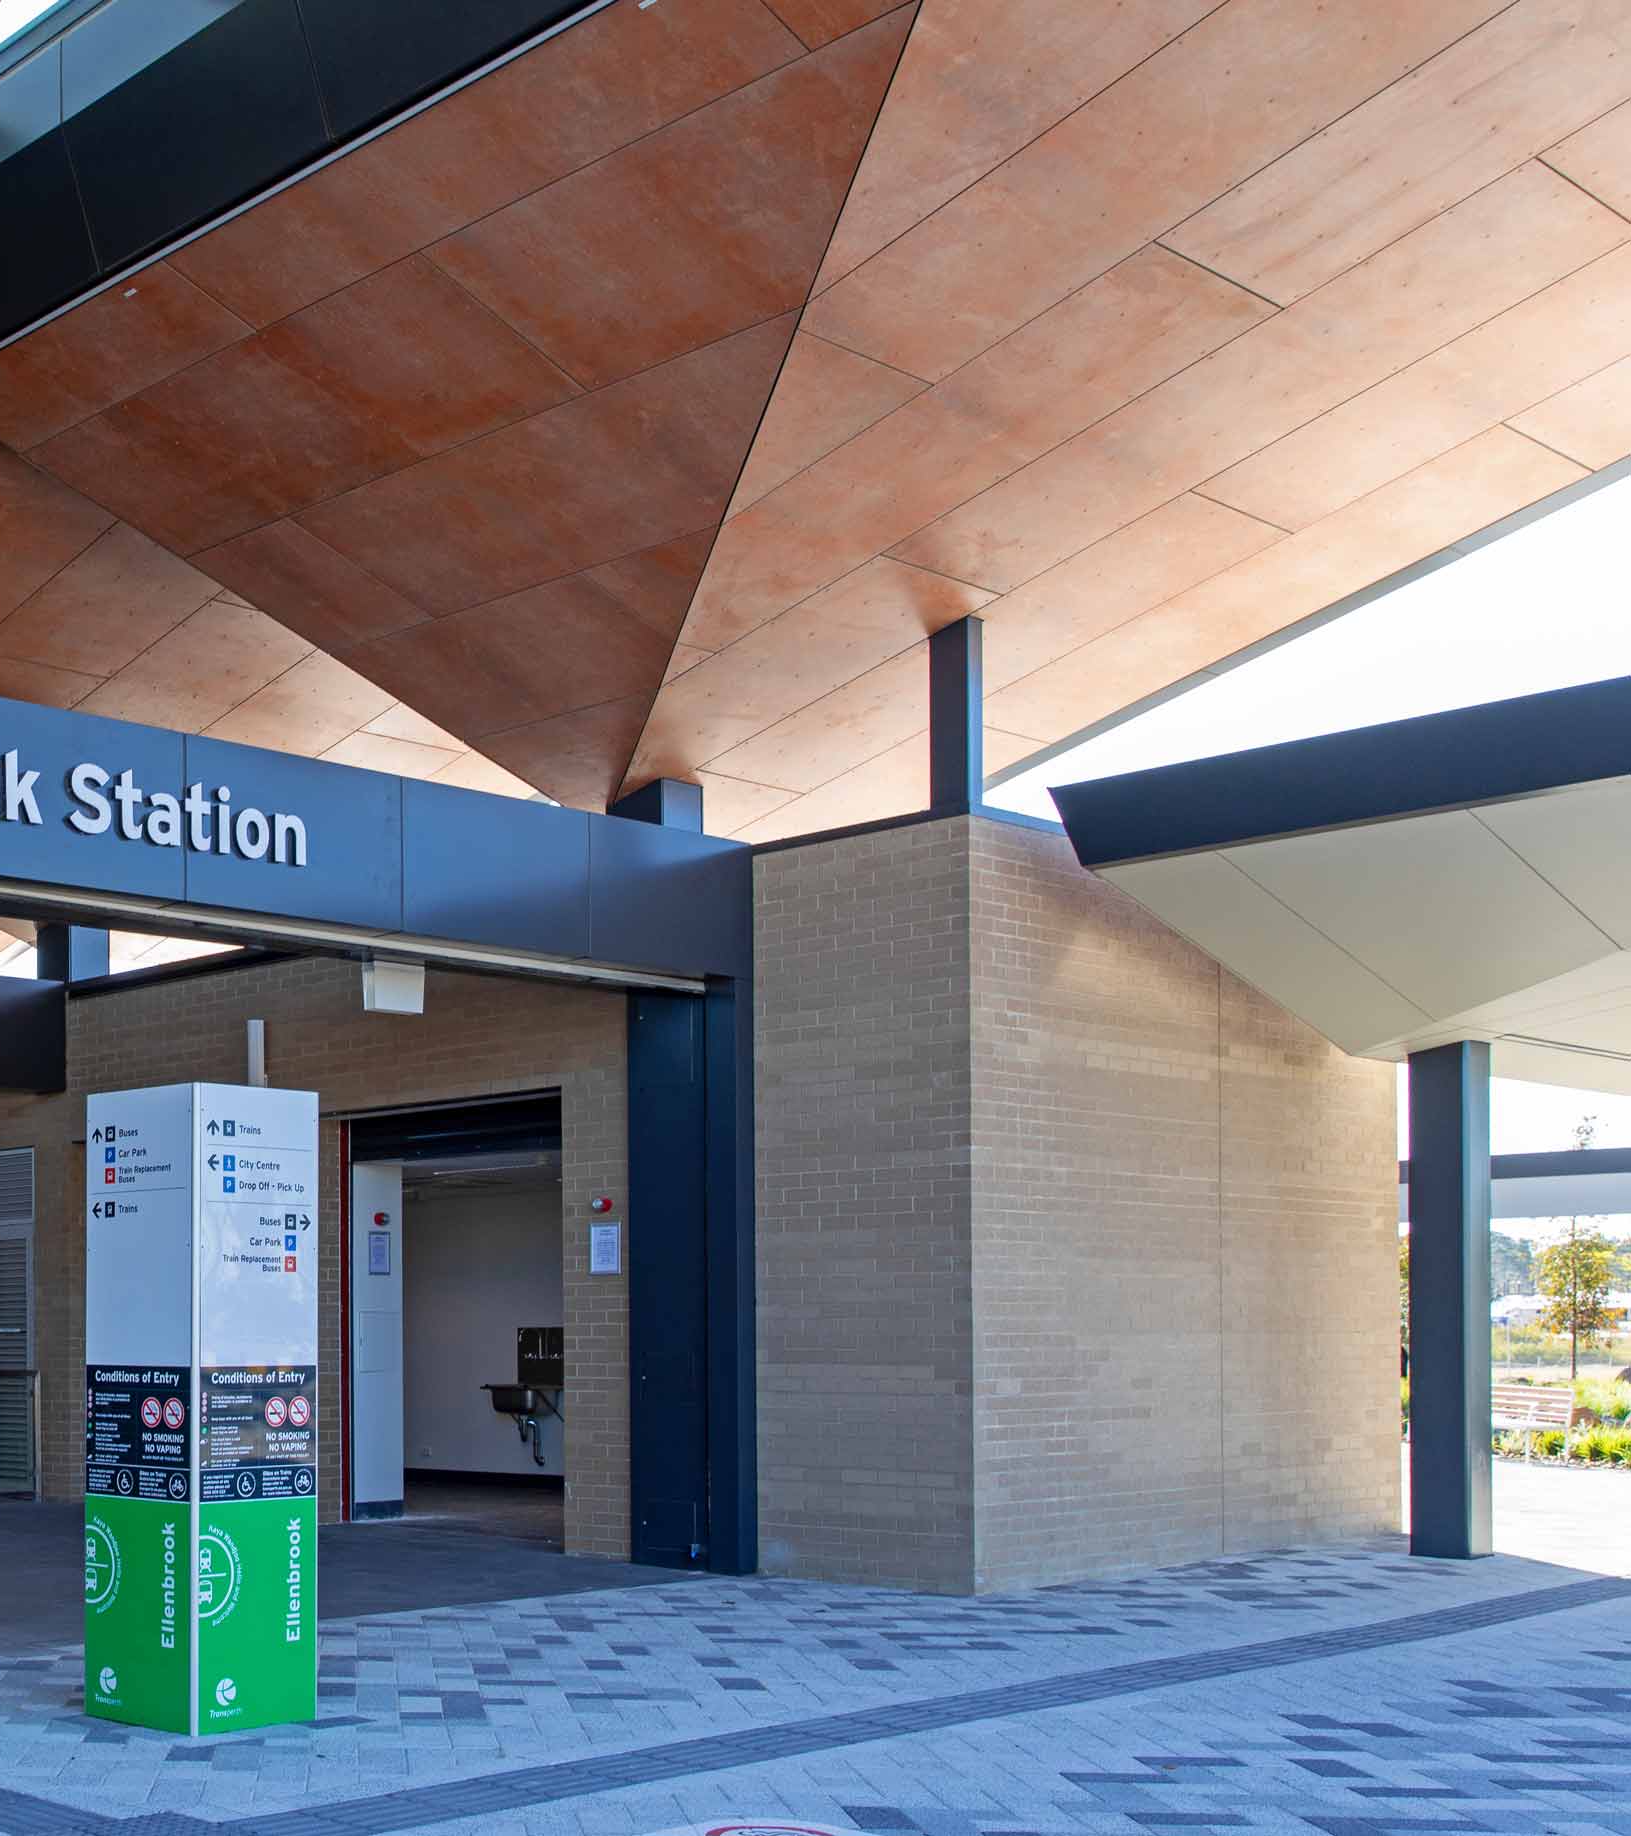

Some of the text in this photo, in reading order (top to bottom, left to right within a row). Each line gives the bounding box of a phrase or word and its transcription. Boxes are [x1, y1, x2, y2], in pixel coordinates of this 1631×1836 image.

[67, 763, 308, 867] Station
[118, 1128, 139, 1138] Buses
[239, 1124, 262, 1135] Trains
[118, 1148, 130, 1159] Car
[131, 1147, 147, 1157] Park
[119, 1163, 172, 1175] Train Replacement
[239, 1159, 281, 1171] City Centre
[118, 1175, 136, 1184] Buses
[239, 1181, 257, 1191] Drop
[258, 1181, 270, 1191] Off
[277, 1183, 293, 1192] Pick
[294, 1184, 305, 1193] Up
[118, 1204, 138, 1214] Trains
[259, 1217, 282, 1226] Buses
[249, 1237, 263, 1247] Car
[264, 1238, 282, 1248] Park
[222, 1254, 282, 1266] Train Replacement
[262, 1264, 282, 1273] Buses
[95, 1369, 180, 1387] Conditions of Entry
[211, 1370, 305, 1385] Conditions of Entry
[142, 1432, 185, 1444] NO SMOKING
[265, 1431, 310, 1441] NO SMOKING
[144, 1444, 182, 1455] NO VAPING
[268, 1442, 307, 1453] NO VAPING
[161, 1522, 175, 1649] Ellenbrook
[286, 1517, 301, 1642] Ellenbrook
